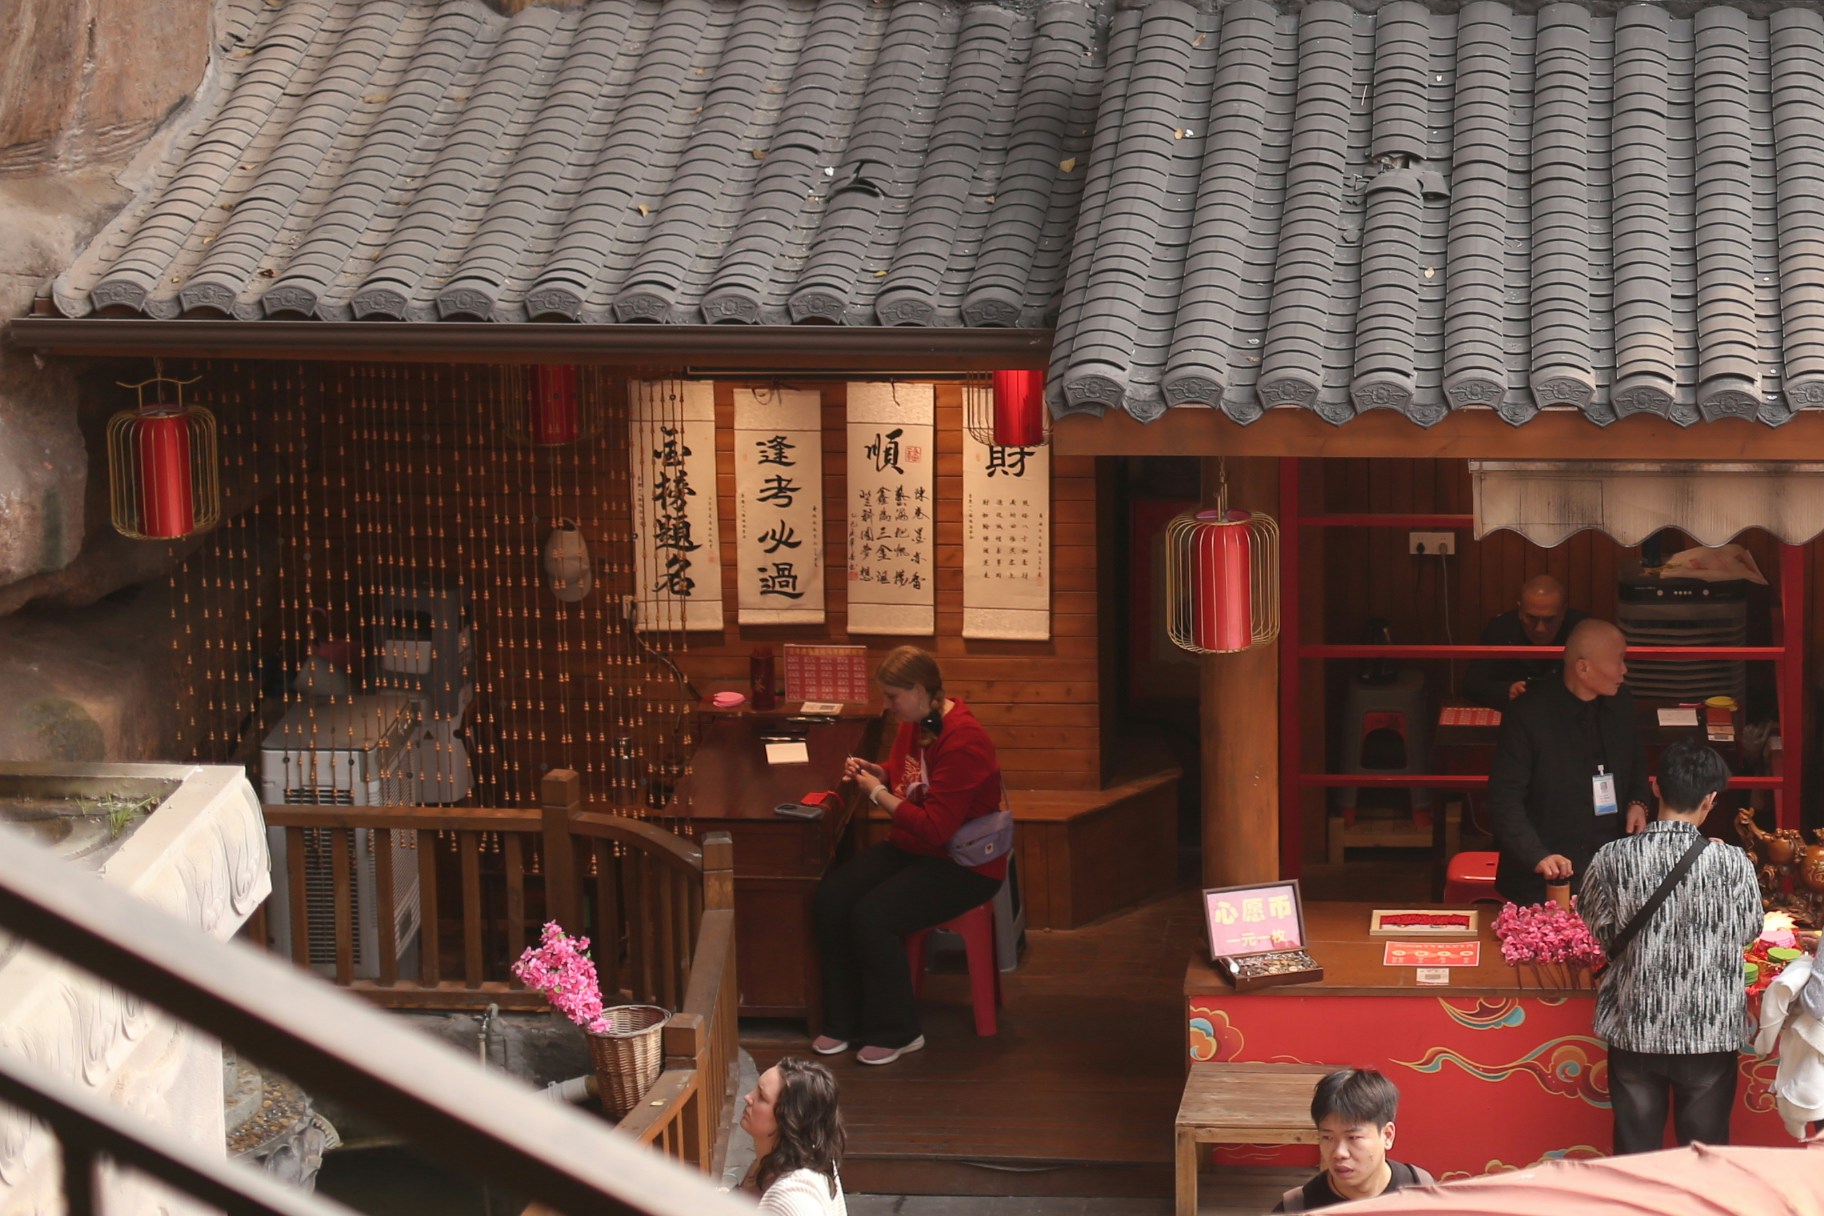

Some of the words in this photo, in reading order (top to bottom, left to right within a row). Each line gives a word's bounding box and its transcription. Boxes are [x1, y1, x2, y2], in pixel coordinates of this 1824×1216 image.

[864, 428, 905, 475] 順
[755, 435, 804, 599] 逢考必過
[1215, 894, 1292, 925] 心愿币
[1226, 929, 1286, 947] 一元一枚
